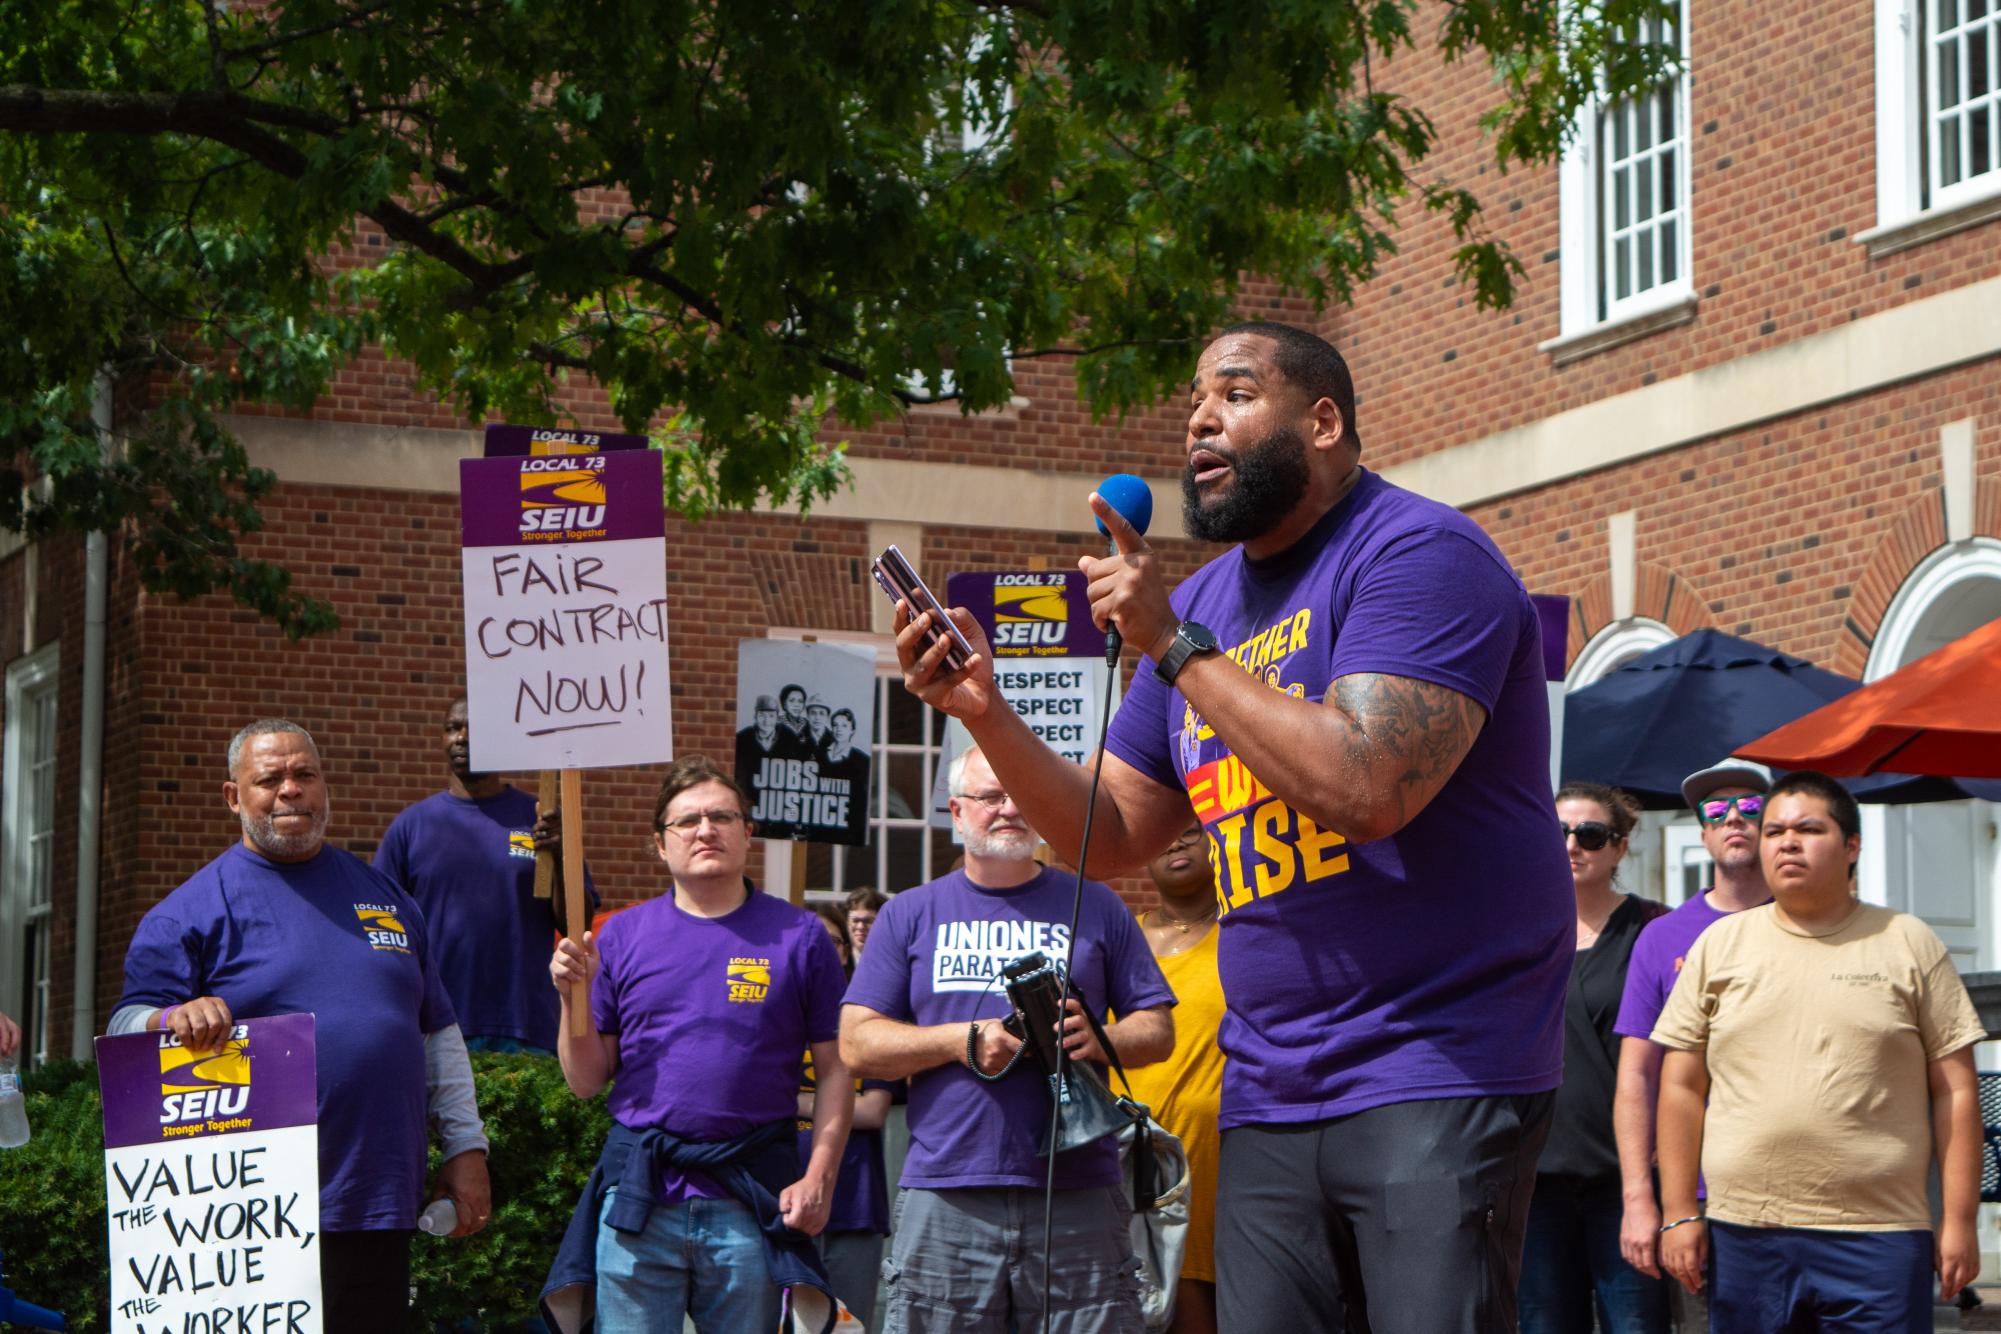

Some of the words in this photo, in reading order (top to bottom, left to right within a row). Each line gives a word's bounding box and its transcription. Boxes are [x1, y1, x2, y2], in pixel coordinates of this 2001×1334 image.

[531, 430, 578, 443] LOCAL
[582, 434, 600, 445] 73
[520, 458, 579, 472] LOCAL
[585, 457, 606, 469] 73
[519, 505, 606, 531] SEIU
[522, 530, 564, 541] Stronger
[566, 528, 607, 540] Together
[995, 574, 1043, 586] LOCAL
[1048, 573, 1066, 585] 73
[477, 598, 669, 659] CONTRACT
[993, 622, 1067, 645] SEIU
[995, 646, 1030, 656] Stronger
[1033, 645, 1068, 656] Together
[515, 659, 645, 723] NOW!
[1007, 698, 1084, 715] SPECT
[1031, 724, 1084, 742] PECT
[752, 757, 819, 792] JOBS
[820, 777, 850, 795] WITH
[751, 789, 850, 828] JUSTICE
[353, 903, 383, 912] LOCAL
[367, 931, 408, 948] SEIU
[936, 920, 1071, 951] UNIONES
[729, 957, 757, 965] LOCAL
[729, 984, 768, 999] SEIU
[159, 1087, 250, 1124] SEIU
[163, 1122, 204, 1138] Stronger
[206, 1117, 252, 1134] Together
[112, 1147, 266, 1203] VALUE
[112, 1204, 157, 1232] THE
[163, 1192, 315, 1249] WORK,
[129, 1246, 264, 1295] VALUE
[118, 1297, 162, 1319] THE
